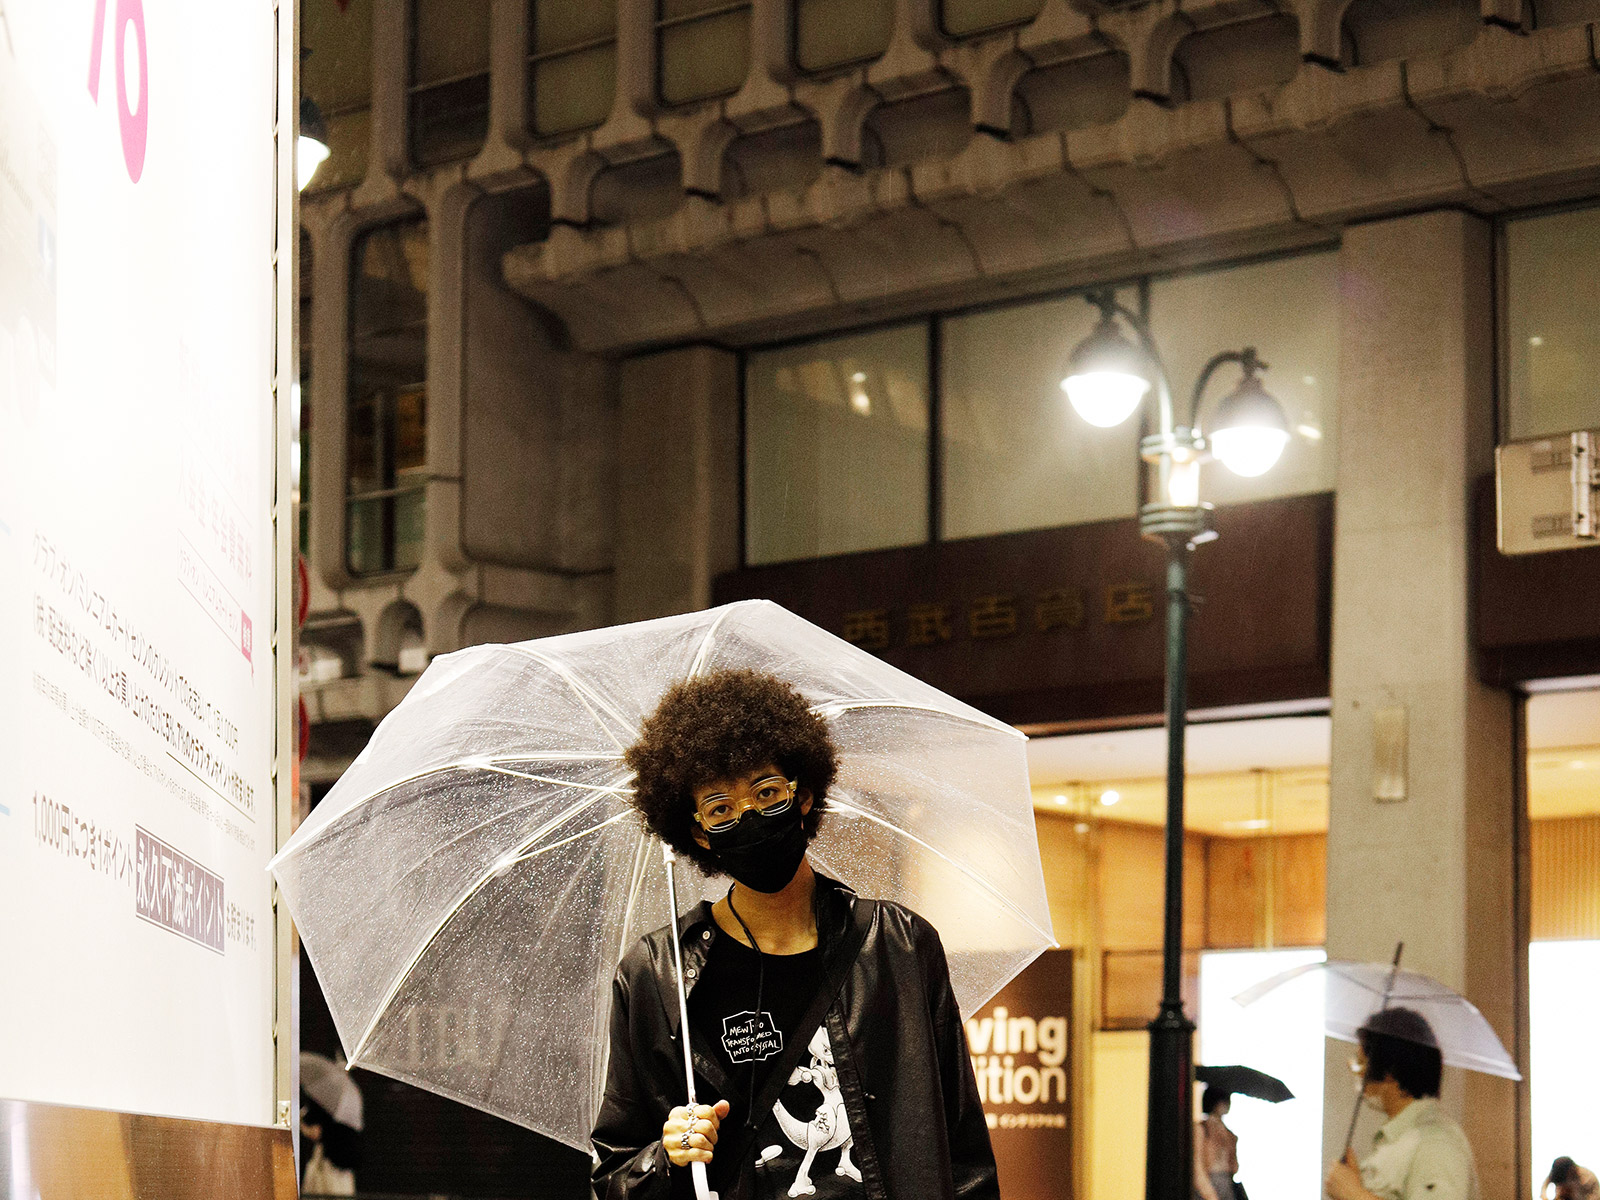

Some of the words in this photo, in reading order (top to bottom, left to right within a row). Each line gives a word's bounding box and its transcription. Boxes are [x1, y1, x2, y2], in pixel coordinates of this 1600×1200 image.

[843, 583, 1154, 648] 西武百貨店
[729, 1019, 764, 1036] MEWTO
[726, 1032, 772, 1047] TRANSFOMED
[733, 1046, 751, 1057] INTO
[971, 1055, 1067, 1105] ition
